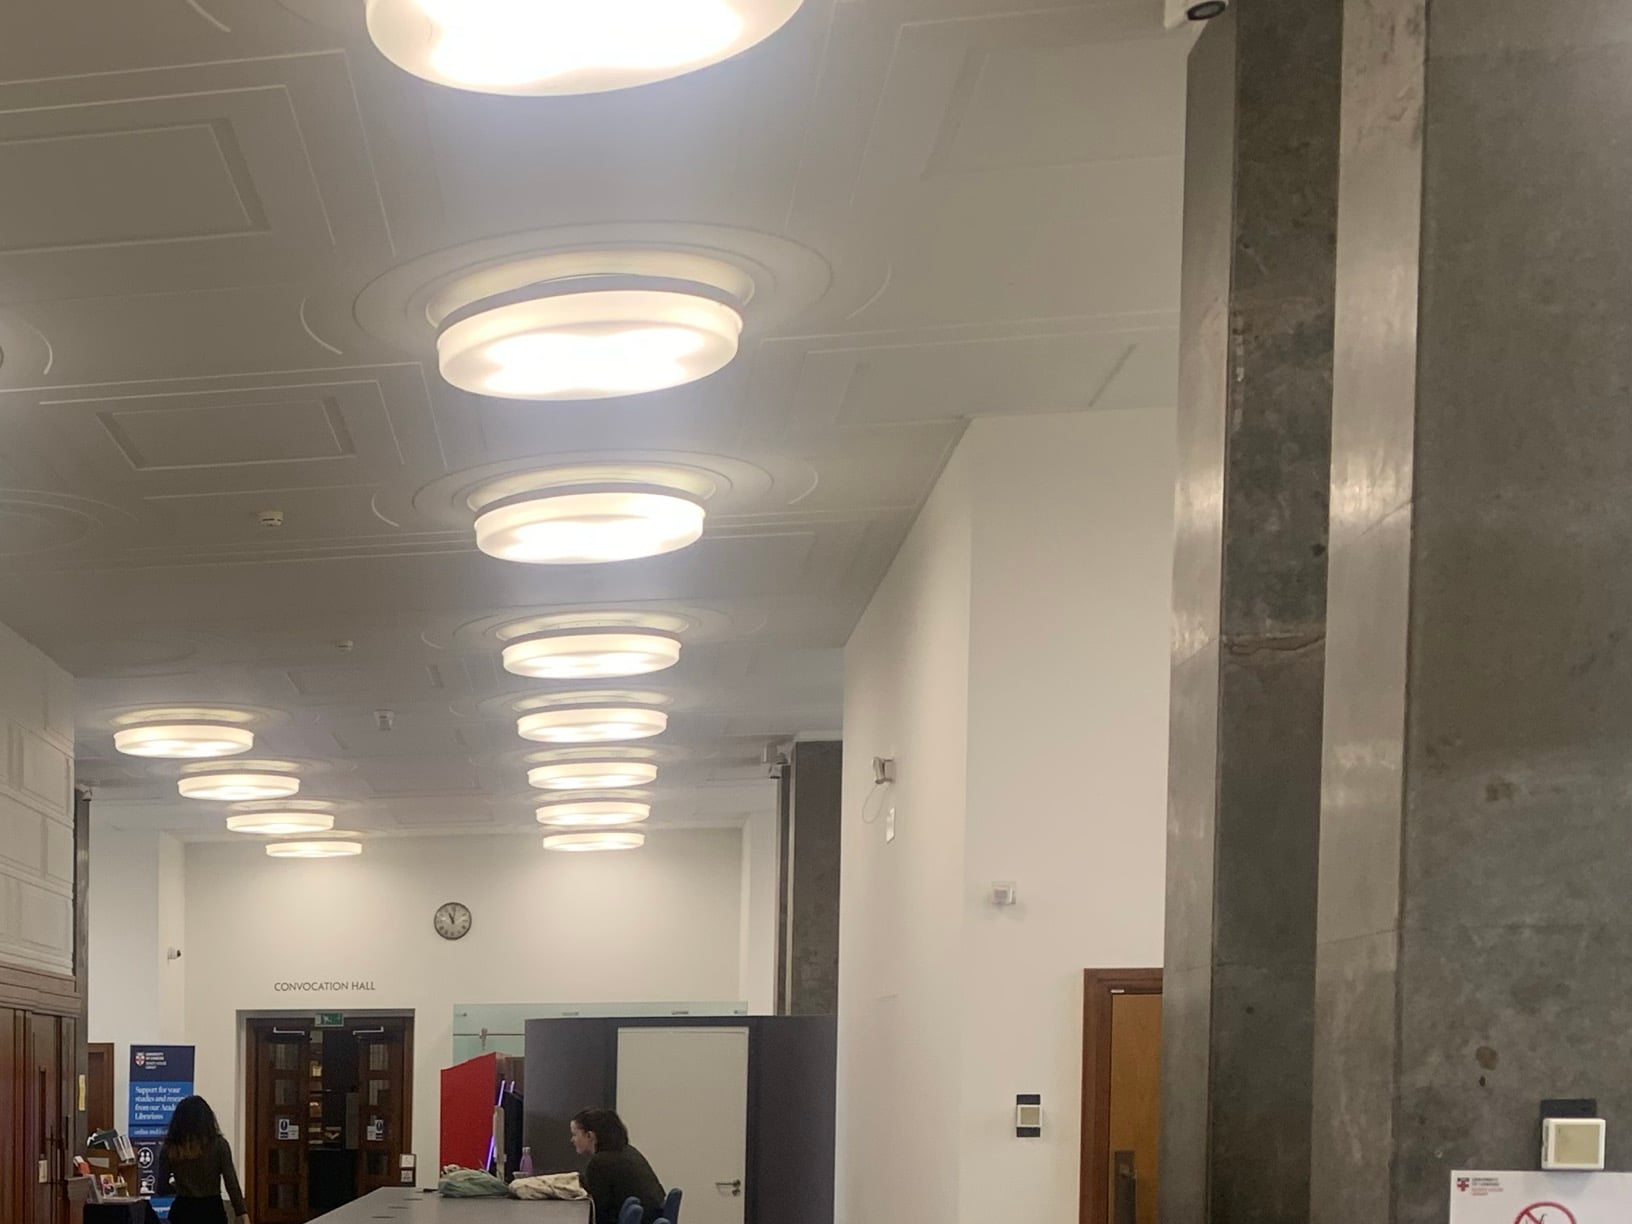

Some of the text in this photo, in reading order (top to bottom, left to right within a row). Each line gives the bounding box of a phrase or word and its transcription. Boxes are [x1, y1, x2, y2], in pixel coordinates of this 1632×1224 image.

[273, 981, 376, 991] CONVOCATION HALL
[135, 1086, 158, 1095] Support
